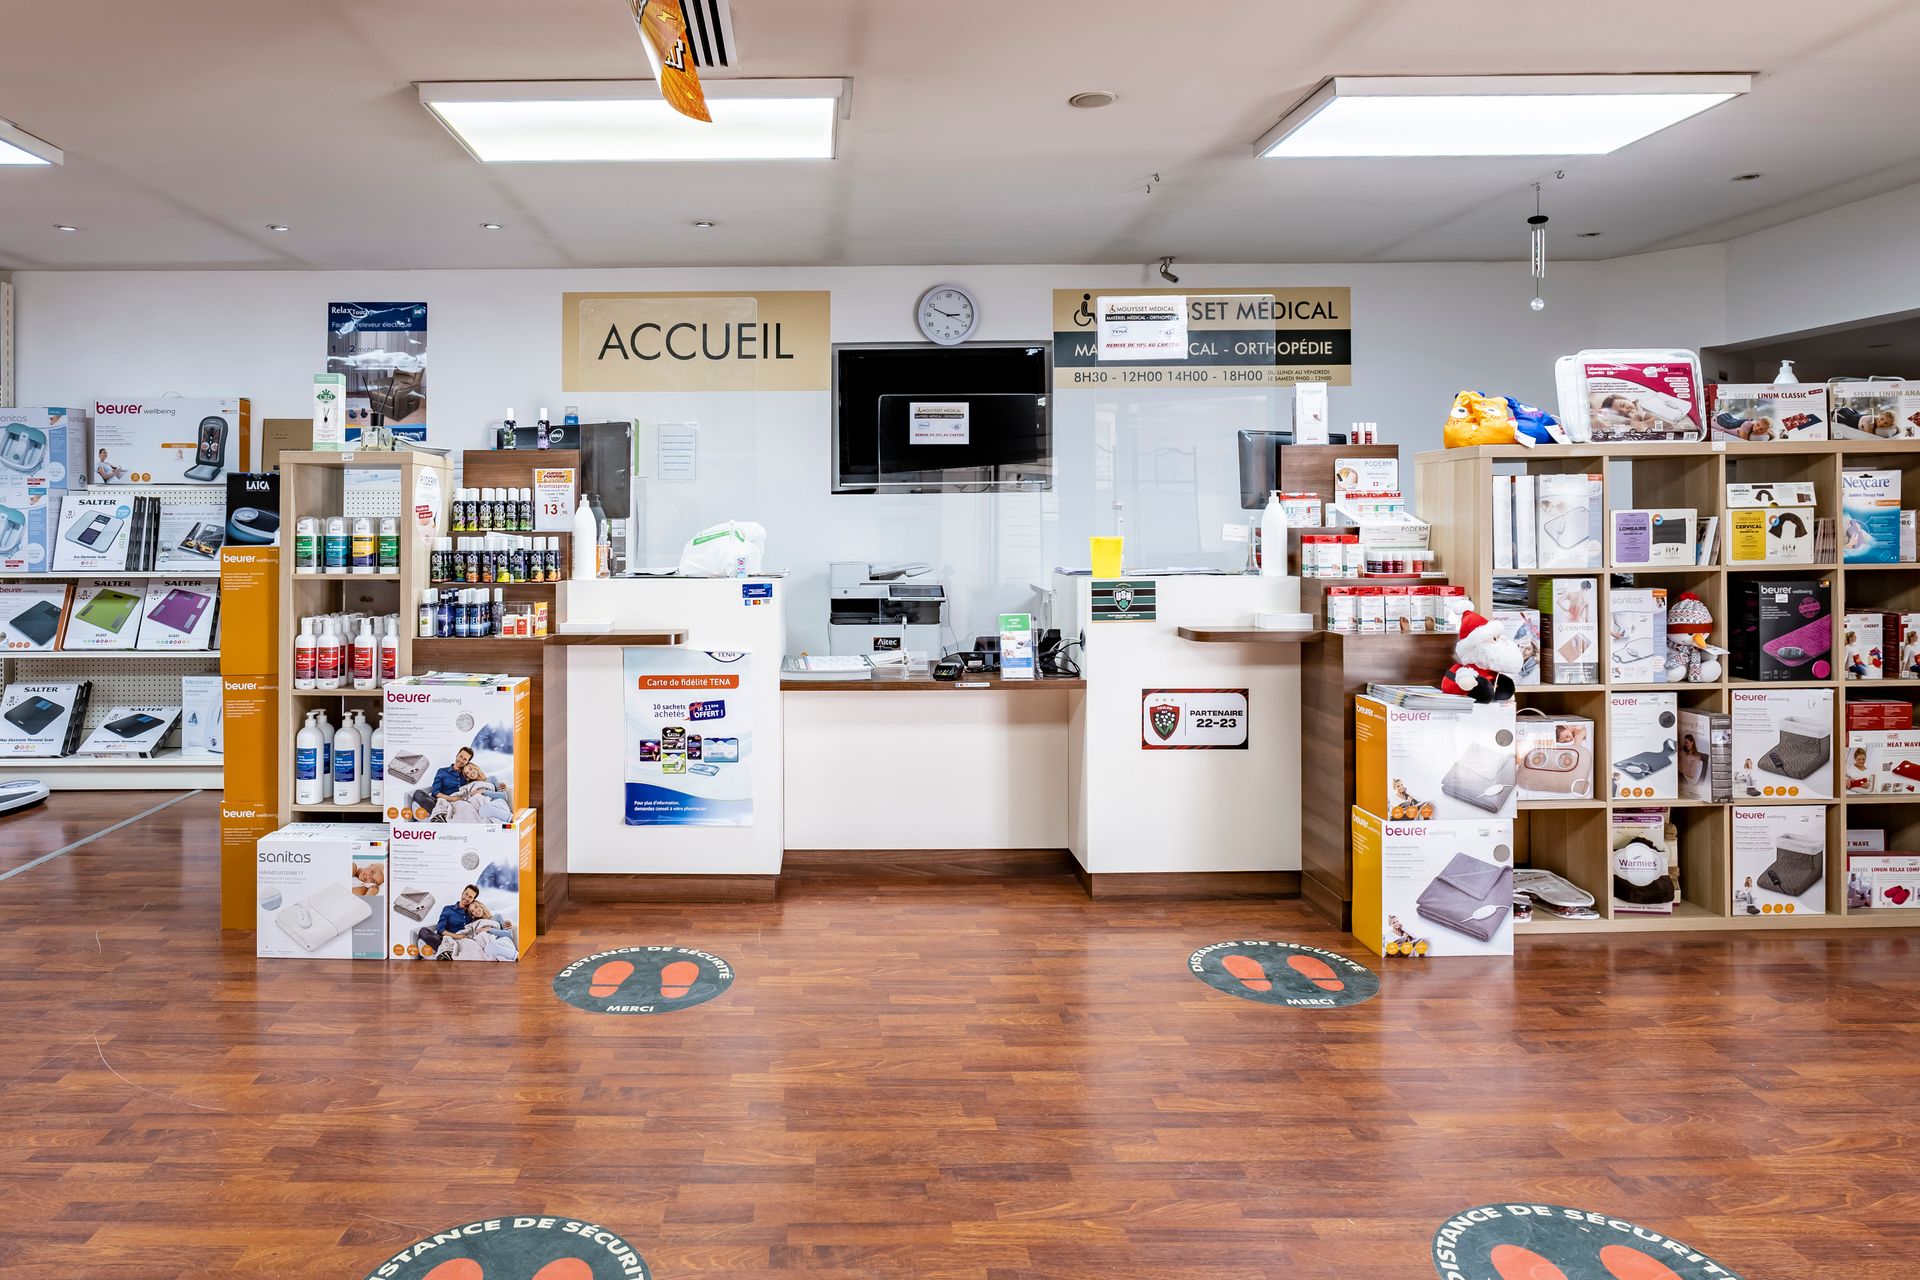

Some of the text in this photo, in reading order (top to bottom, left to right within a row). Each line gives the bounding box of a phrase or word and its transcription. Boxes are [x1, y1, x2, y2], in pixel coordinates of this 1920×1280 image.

[332, 306, 350, 314] Relax
[1187, 297, 1338, 321] SET MÉDICAL
[598, 323, 794, 361] ACCUEIL
[1075, 338, 1333, 357] MA CAL ORTHOPÉDIE
[1074, 370, 1263, 383] 8H30 12H00 14H00 18H00
[1781, 391, 1807, 399] CLASSIC
[96, 402, 176, 416] beurer wellbeing
[0, 414, 28, 422] anitas
[246, 481, 270, 490] LAICA
[1842, 477, 1890, 490] Nexcare
[543, 503, 558, 515] 13
[224, 553, 256, 563] beurer
[1761, 585, 1792, 594] beurer
[1612, 596, 1643, 604] sanitas
[225, 680, 257, 690] beurer
[647, 678, 731, 686] Carte de fidélité TENA
[387, 691, 462, 705] beurer wellbeing
[1734, 693, 1767, 701] beurer
[654, 710, 685, 718] achetés
[694, 710, 719, 718] OFFERT
[1356, 703, 1374, 717] beurer
[1390, 710, 1431, 721] beurer
[1196, 718, 1237, 728] 22-23
[223, 808, 256, 819] beurer
[1735, 811, 1766, 820] beurer
[1353, 813, 1369, 829] beurer
[393, 827, 467, 842] beurer wellbeing
[1385, 824, 1427, 836] beurer
[259, 850, 311, 863] sanitas
[1619, 858, 1657, 867] Warmies
[1190, 941, 1239, 972] DISTANCE
[560, 947, 640, 978] DISTANCE
[1505, 1204, 1553, 1217] DE
[1563, 1208, 1738, 1280] SÉCURIT
[513, 1217, 560, 1229] DE
[562, 1221, 644, 1280] SÉCURIT
